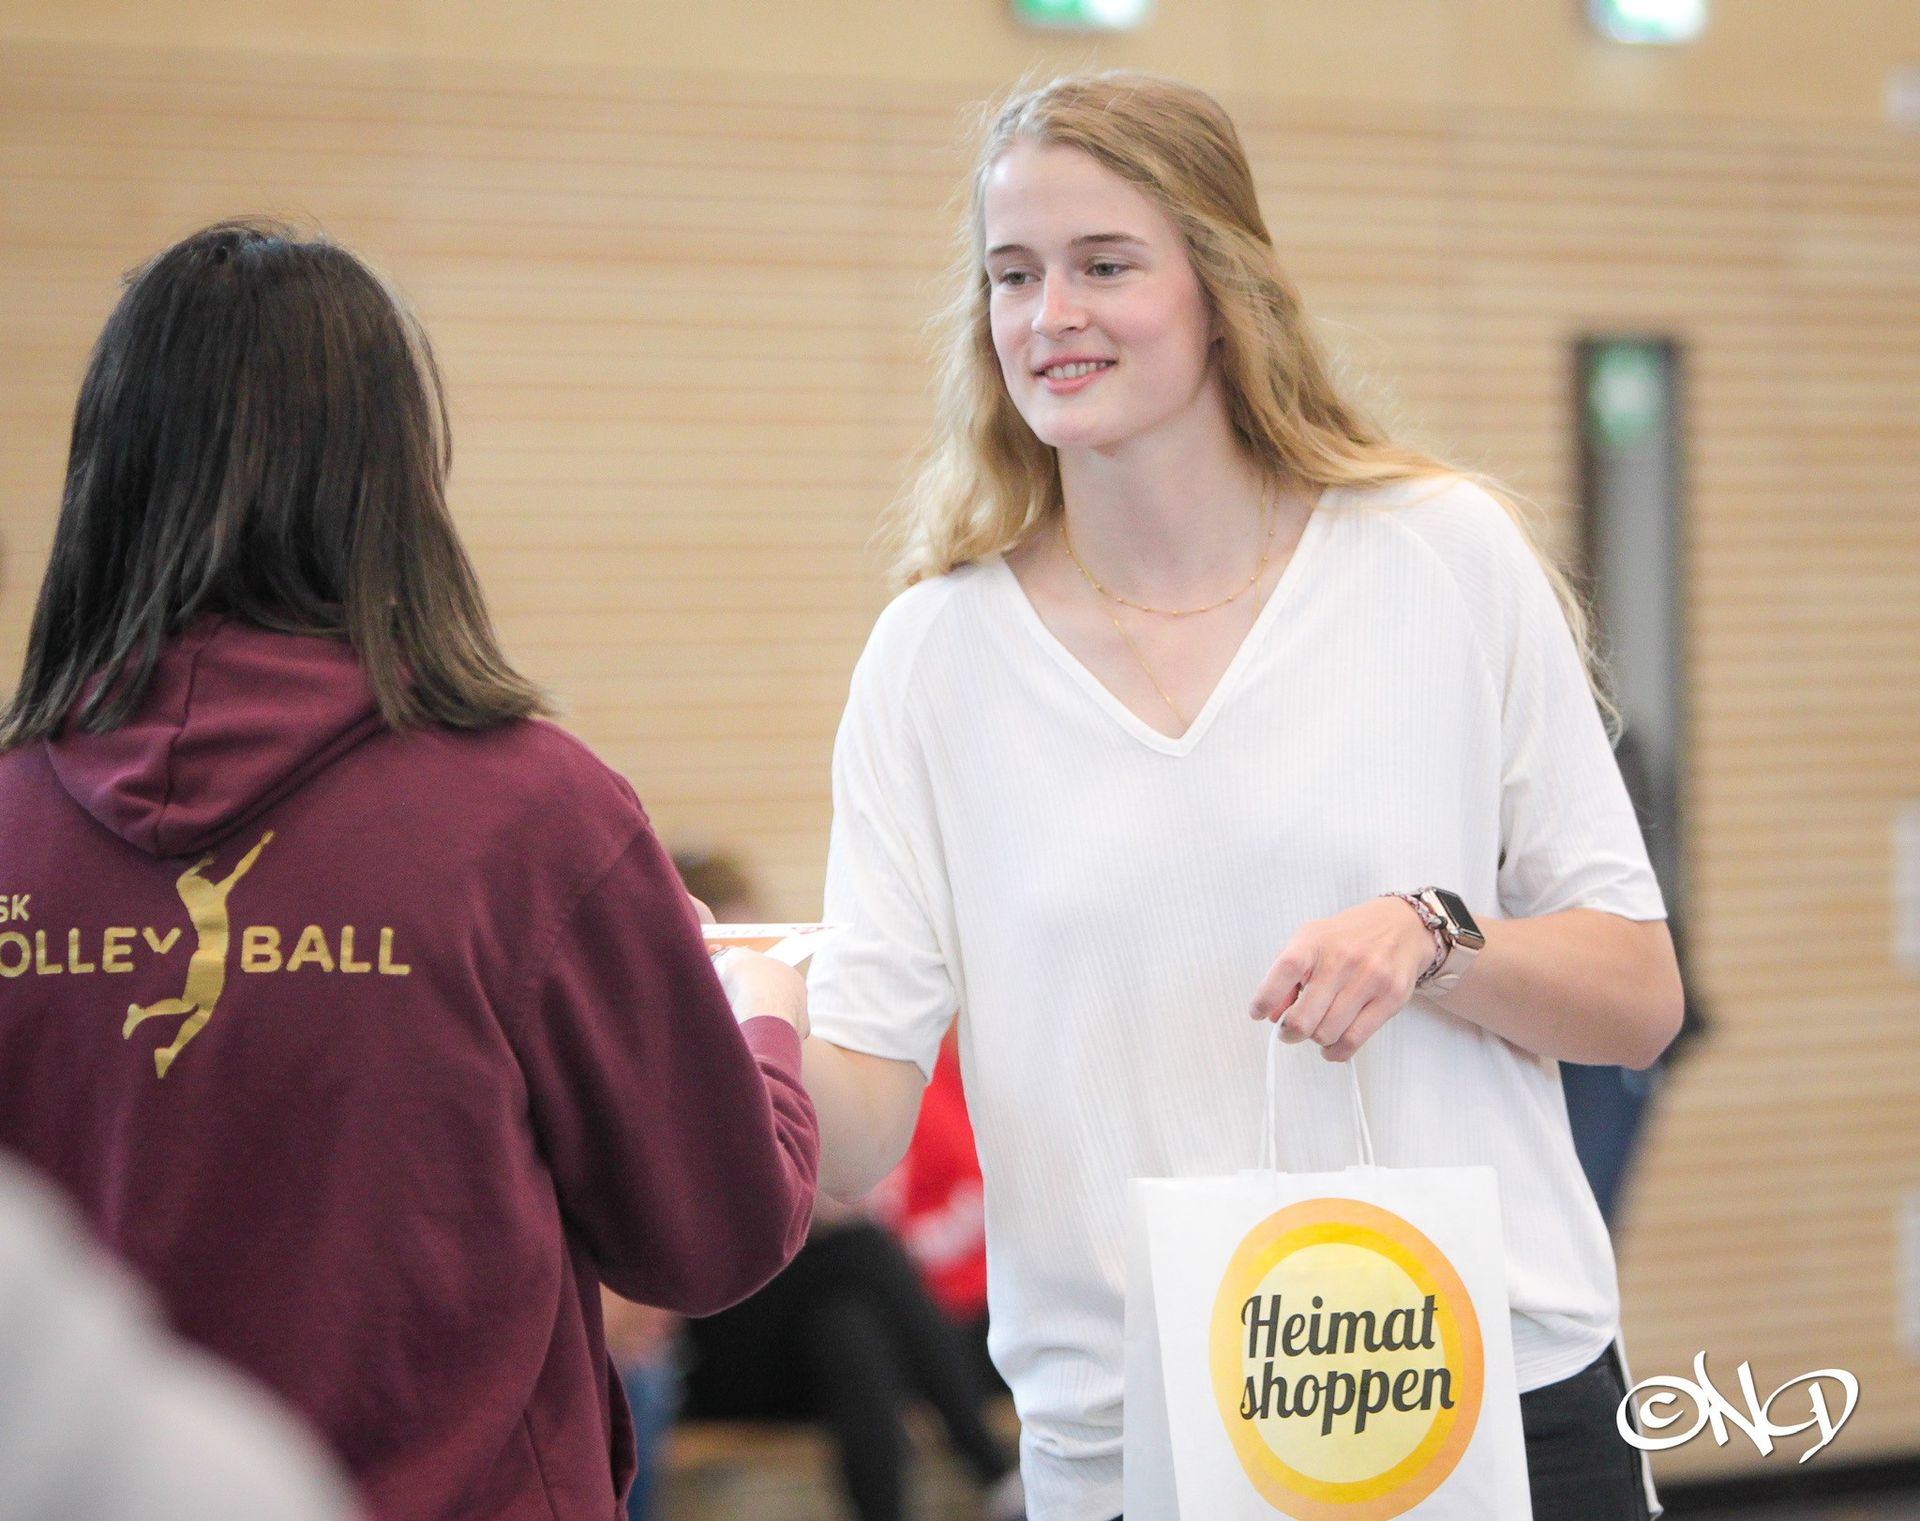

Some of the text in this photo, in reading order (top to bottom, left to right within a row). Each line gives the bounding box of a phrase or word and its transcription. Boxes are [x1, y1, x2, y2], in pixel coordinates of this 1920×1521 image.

[240, 925, 411, 975] BALL
[1241, 1294, 1438, 1359] Heimat
[1240, 1361, 1454, 1437] shoppen
